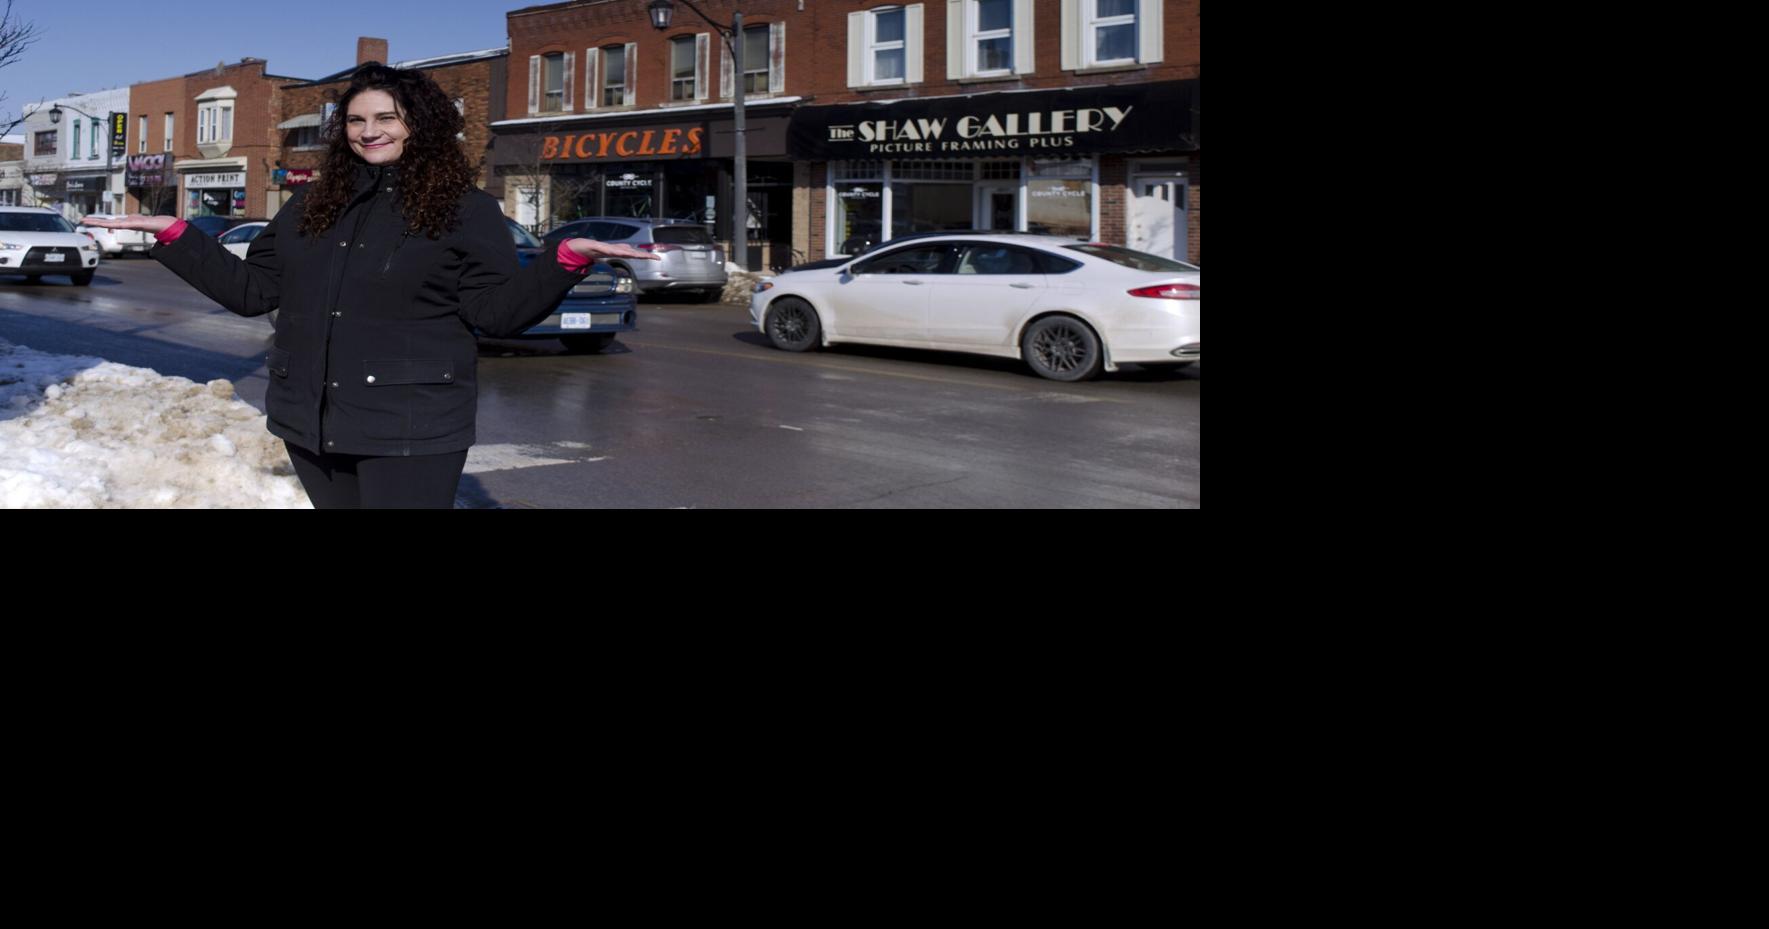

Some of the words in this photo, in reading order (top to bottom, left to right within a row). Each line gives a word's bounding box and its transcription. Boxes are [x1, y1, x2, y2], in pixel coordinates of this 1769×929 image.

[828, 127, 854, 140] The
[858, 118, 947, 142] SHAW
[956, 105, 1133, 139] GALLERY
[540, 127, 703, 160] BICYCLES
[870, 142, 932, 153] PICTURE
[941, 138, 1019, 151] FRAMING
[1029, 136, 1074, 148] PLUS
[191, 174, 215, 184] ACTION
[217, 173, 240, 183] PRINT
